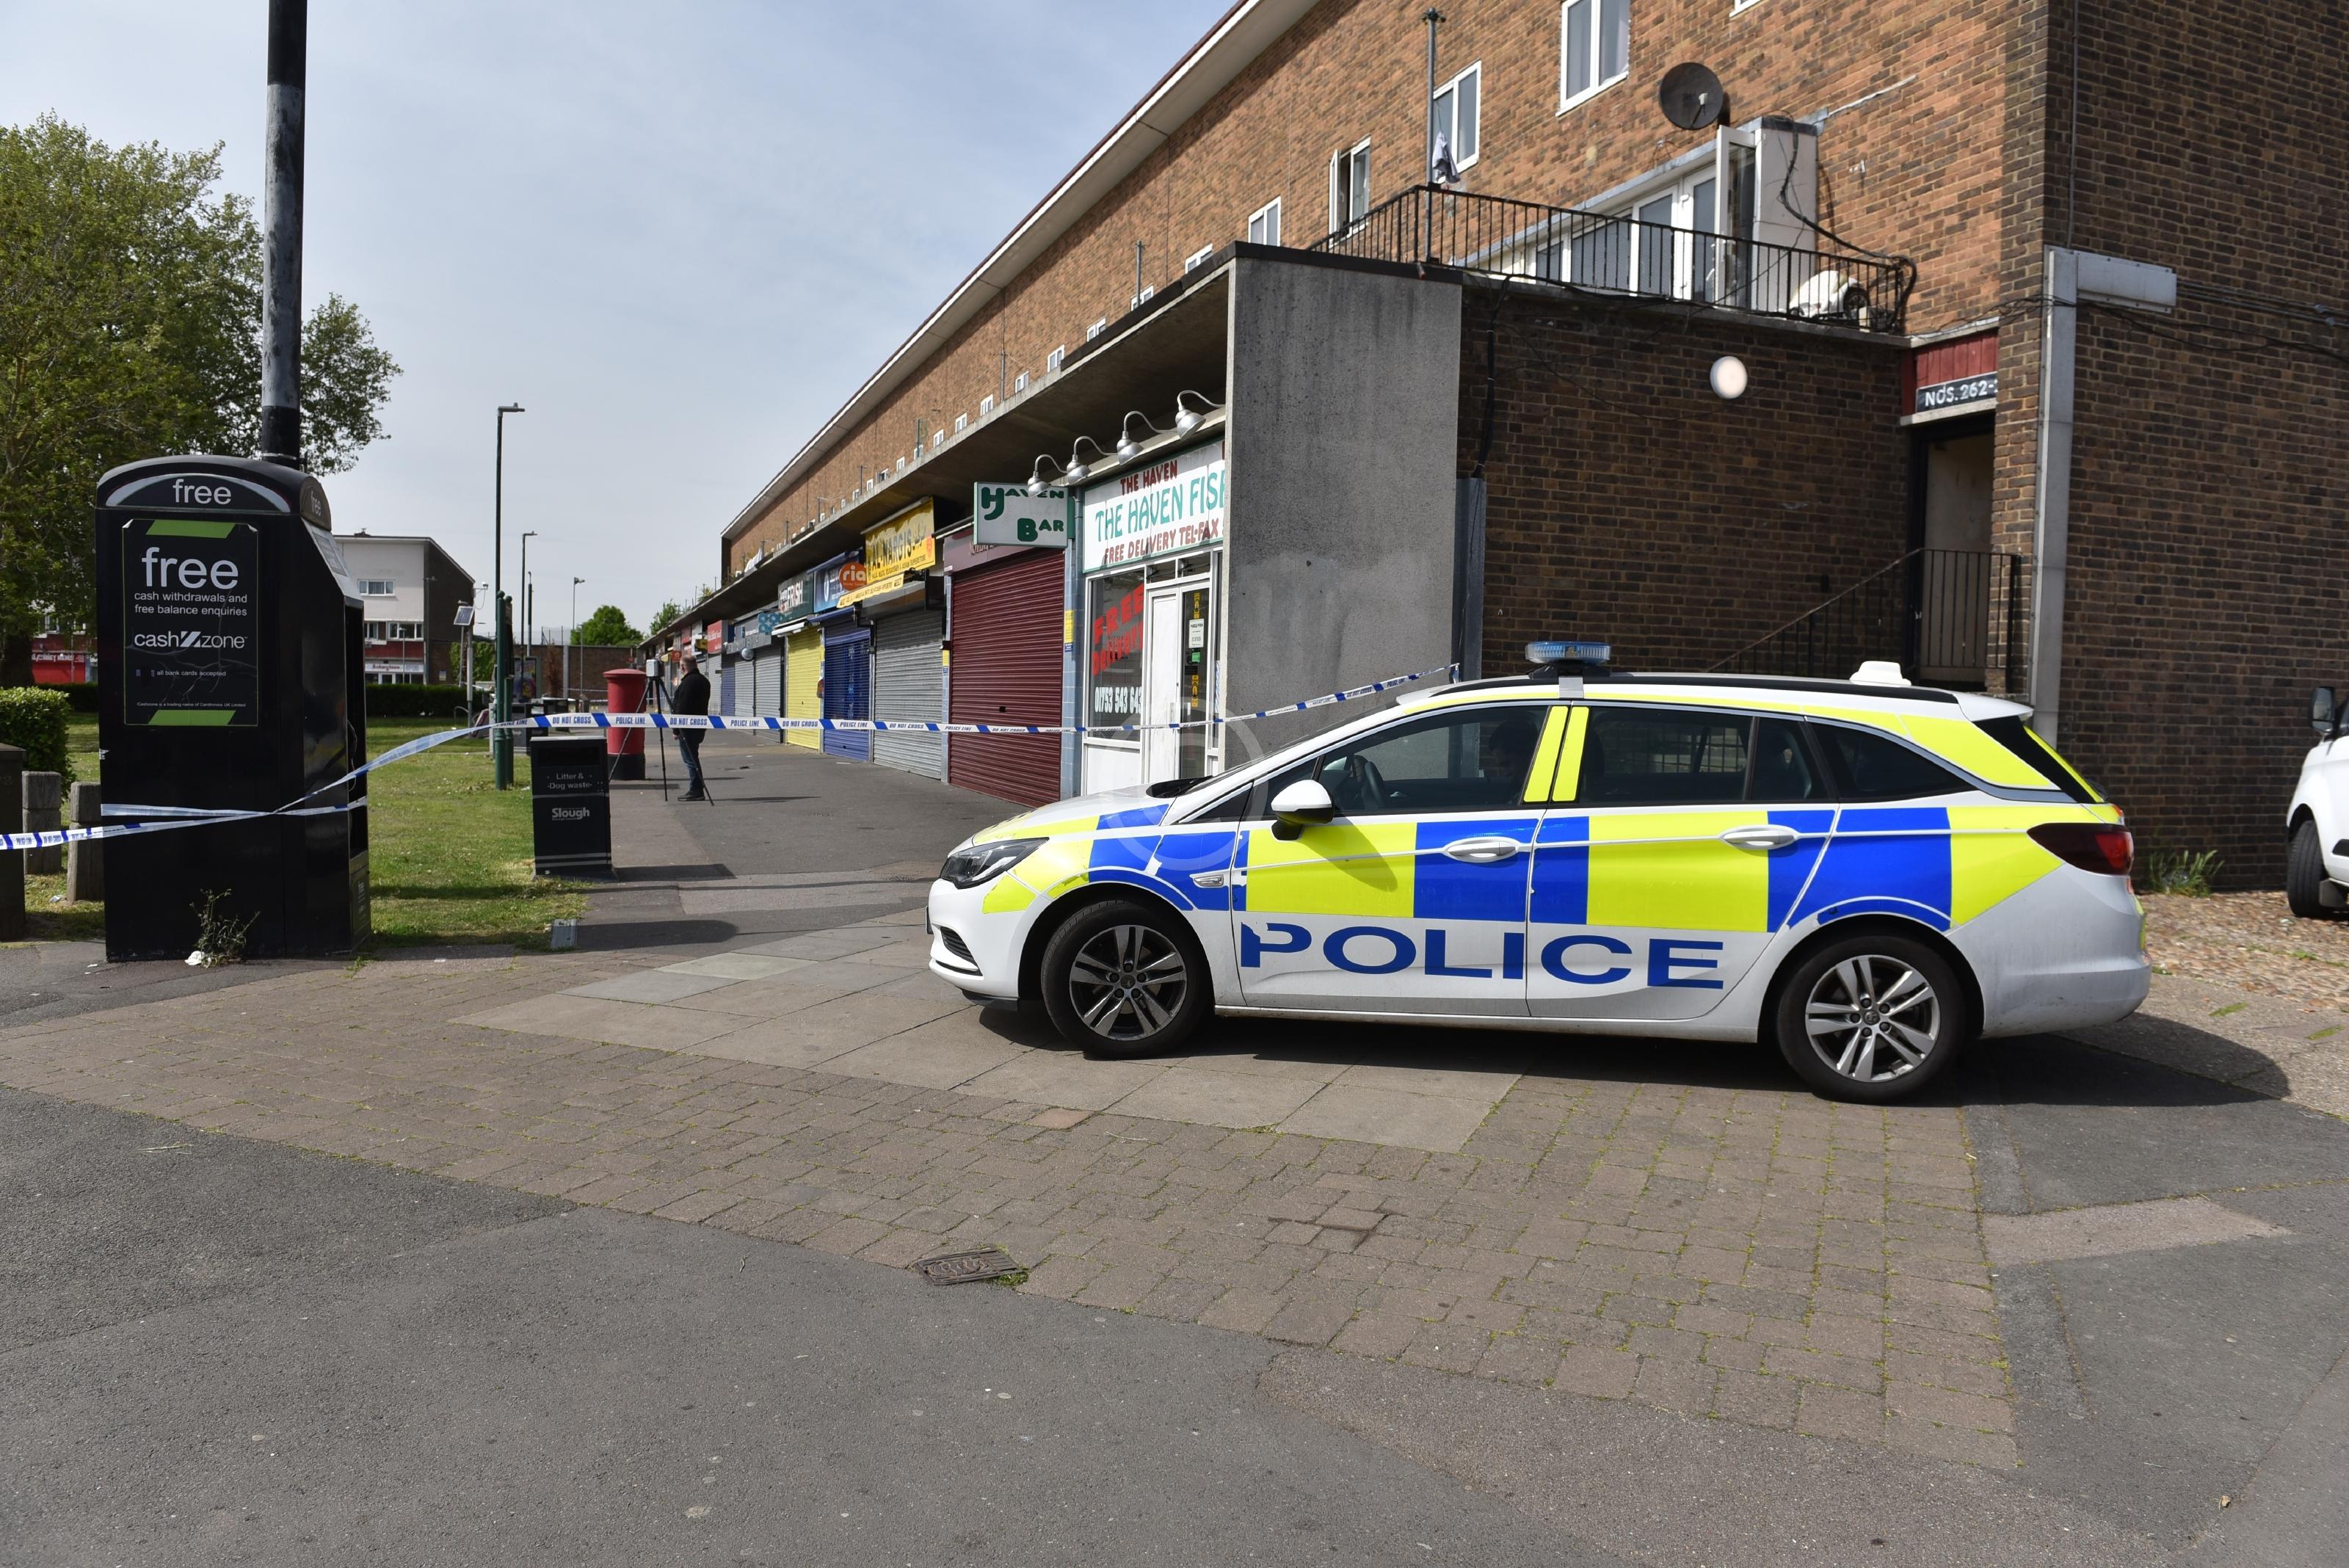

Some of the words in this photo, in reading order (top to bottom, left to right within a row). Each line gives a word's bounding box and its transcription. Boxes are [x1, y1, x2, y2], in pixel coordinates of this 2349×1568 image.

[1119, 475, 1139, 496] THE
[1142, 460, 1177, 487] HAVEN
[173, 479, 232, 505] free
[311, 490, 322, 516] free
[1094, 504, 1124, 542] THE
[1128, 483, 1183, 534] HAVEN
[1104, 545, 1125, 565] FREE
[1128, 529, 1177, 556] DELIVERY
[142, 547, 239, 589] free
[843, 565, 866, 581] ria
[134, 591, 159, 600] cash
[162, 592, 225, 603] withdrawals
[228, 594, 247, 603] and
[134, 604, 154, 614] free
[158, 605, 198, 614] balance
[201, 607, 247, 617] enquiries
[1094, 583, 1144, 645] FREE
[1094, 686, 1114, 714] 01753
[1114, 686, 1128, 714] 543
[1129, 687, 1142, 714] 643
[573, 716, 592, 724] CROSS
[615, 716, 633, 725] POLICE
[635, 716, 646, 725] LINE
[669, 717, 678, 725] DO
[678, 717, 689, 725] NOT
[690, 718, 708, 726] CROSS
[549, 782, 565, 790] Dog
[567, 781, 590, 789] waste
[551, 807, 590, 820] Slough
[1241, 922, 1724, 990] POLICE
